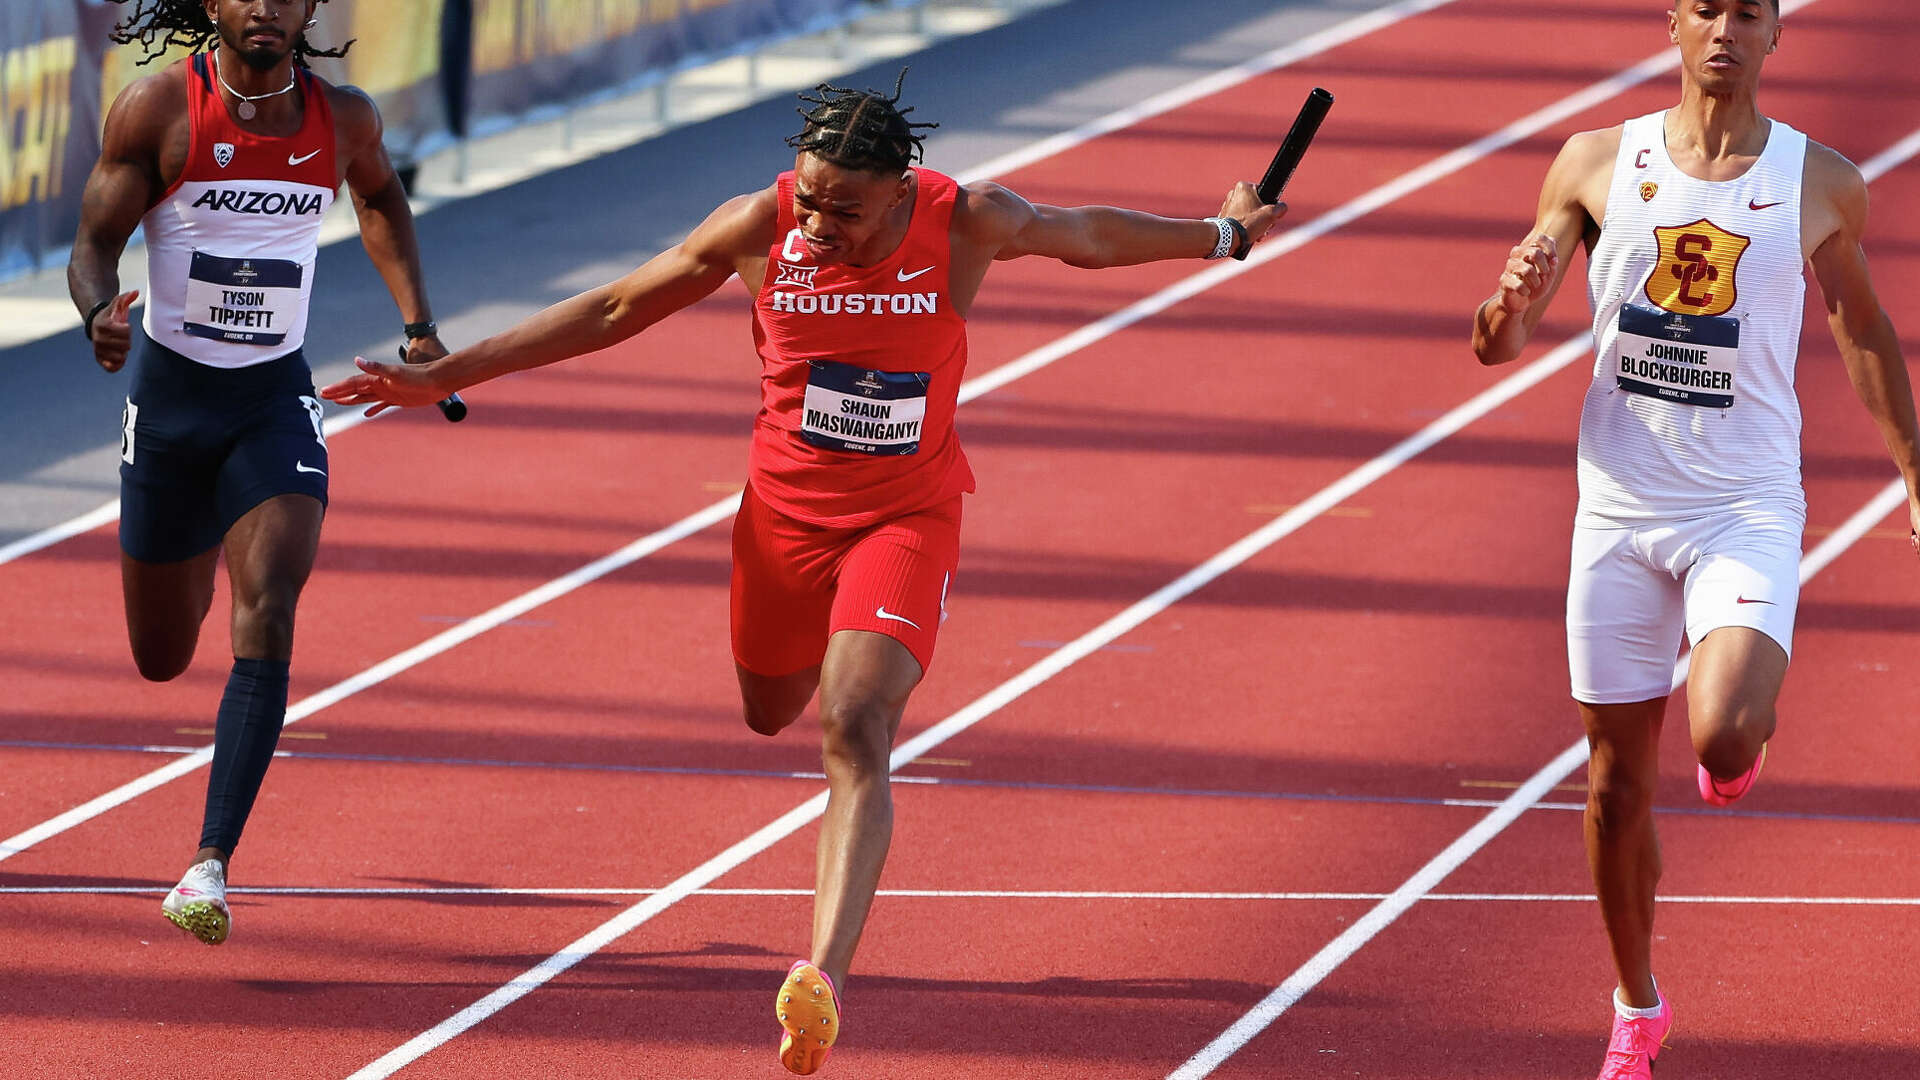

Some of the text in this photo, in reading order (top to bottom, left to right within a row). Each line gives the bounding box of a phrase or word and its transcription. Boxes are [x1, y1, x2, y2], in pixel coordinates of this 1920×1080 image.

[1635, 149, 1650, 168] C
[191, 189, 322, 215] ARIZONA
[782, 228, 803, 262] C
[222, 290, 264, 306] TYSON
[771, 291, 938, 315] HOUSTON
[209, 306, 274, 328] TIPPETT
[1646, 343, 1708, 365] JOHNNIE
[1621, 356, 1732, 390] BLOCKBURGER
[841, 399, 891, 419] SHAUN
[806, 409, 918, 440] MASWANGANYI
